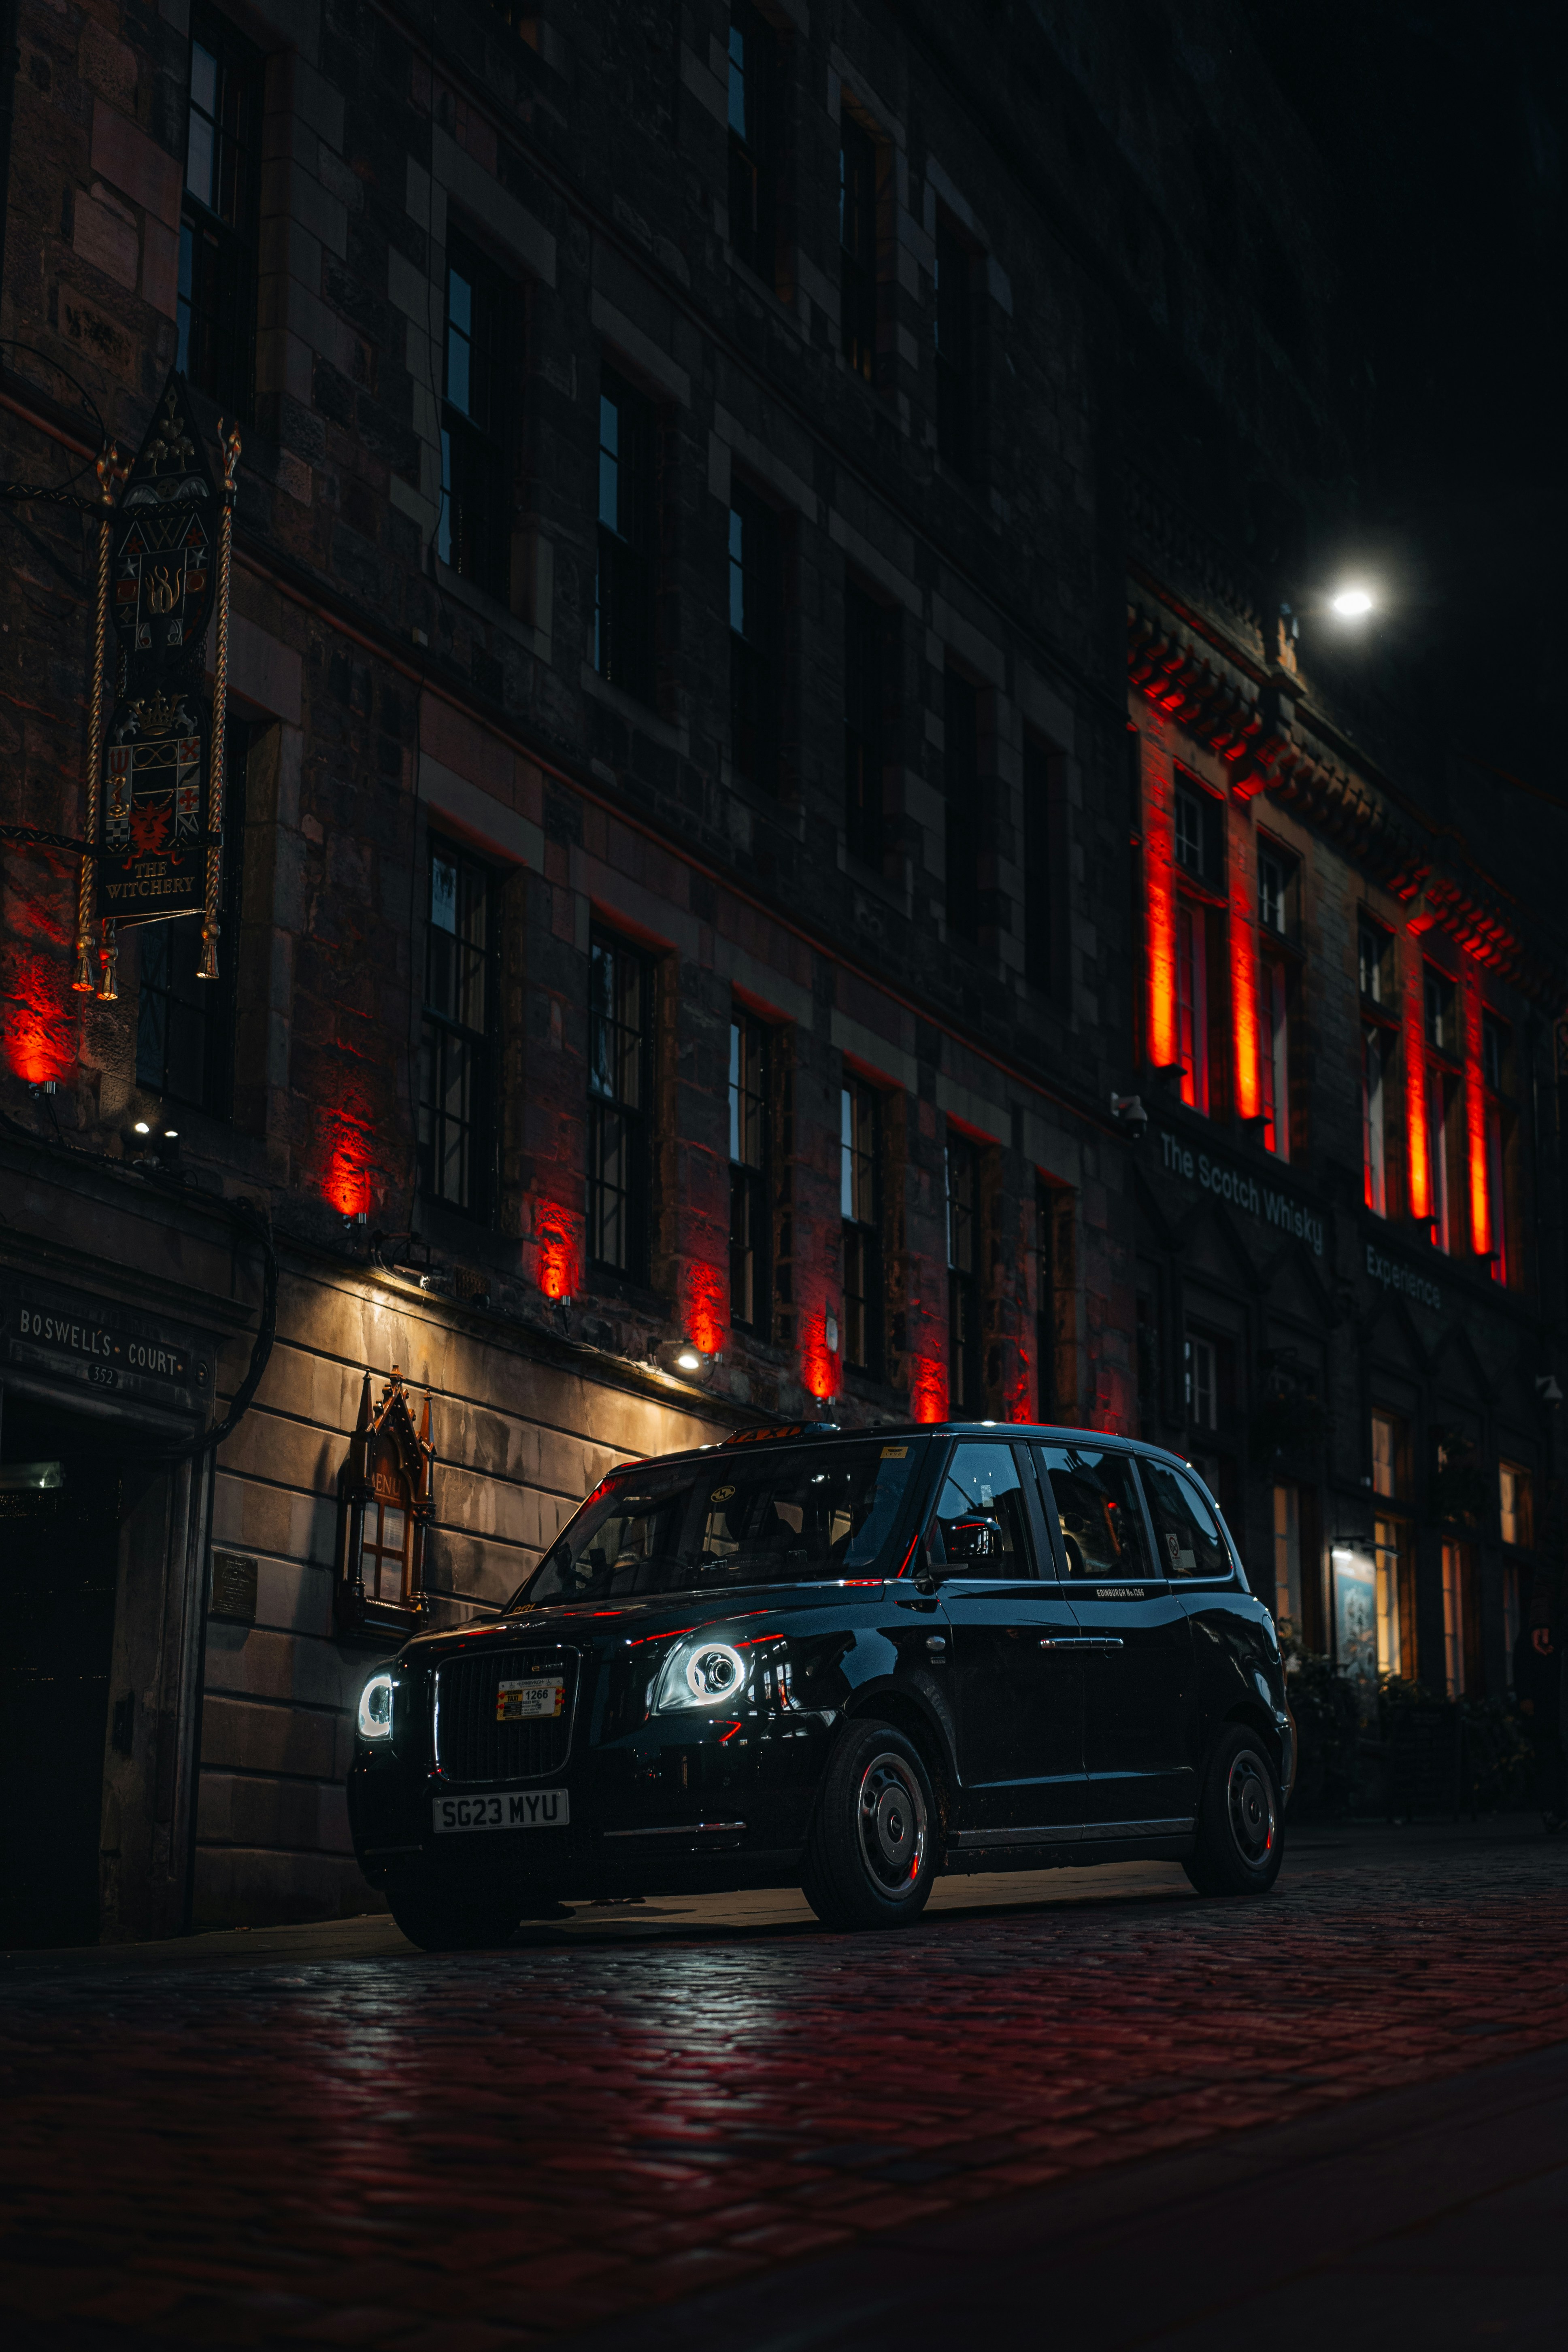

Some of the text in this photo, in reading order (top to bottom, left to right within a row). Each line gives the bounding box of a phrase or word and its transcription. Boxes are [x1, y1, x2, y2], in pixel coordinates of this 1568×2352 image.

[135, 861, 167, 878] THE
[106, 876, 195, 900] WITCHERY
[1160, 1131, 1441, 1309] The Scotch Whisky Experience
[20, 1309, 177, 1376] BOSWELL'S COURT
[93, 1366, 113, 1384] 352
[732, 1426, 796, 1443] TAXI
[1096, 1589, 1126, 1597] EDINBURGH
[526, 1689, 548, 1700] 1266
[443, 1794, 558, 1827] SG23 MYU
